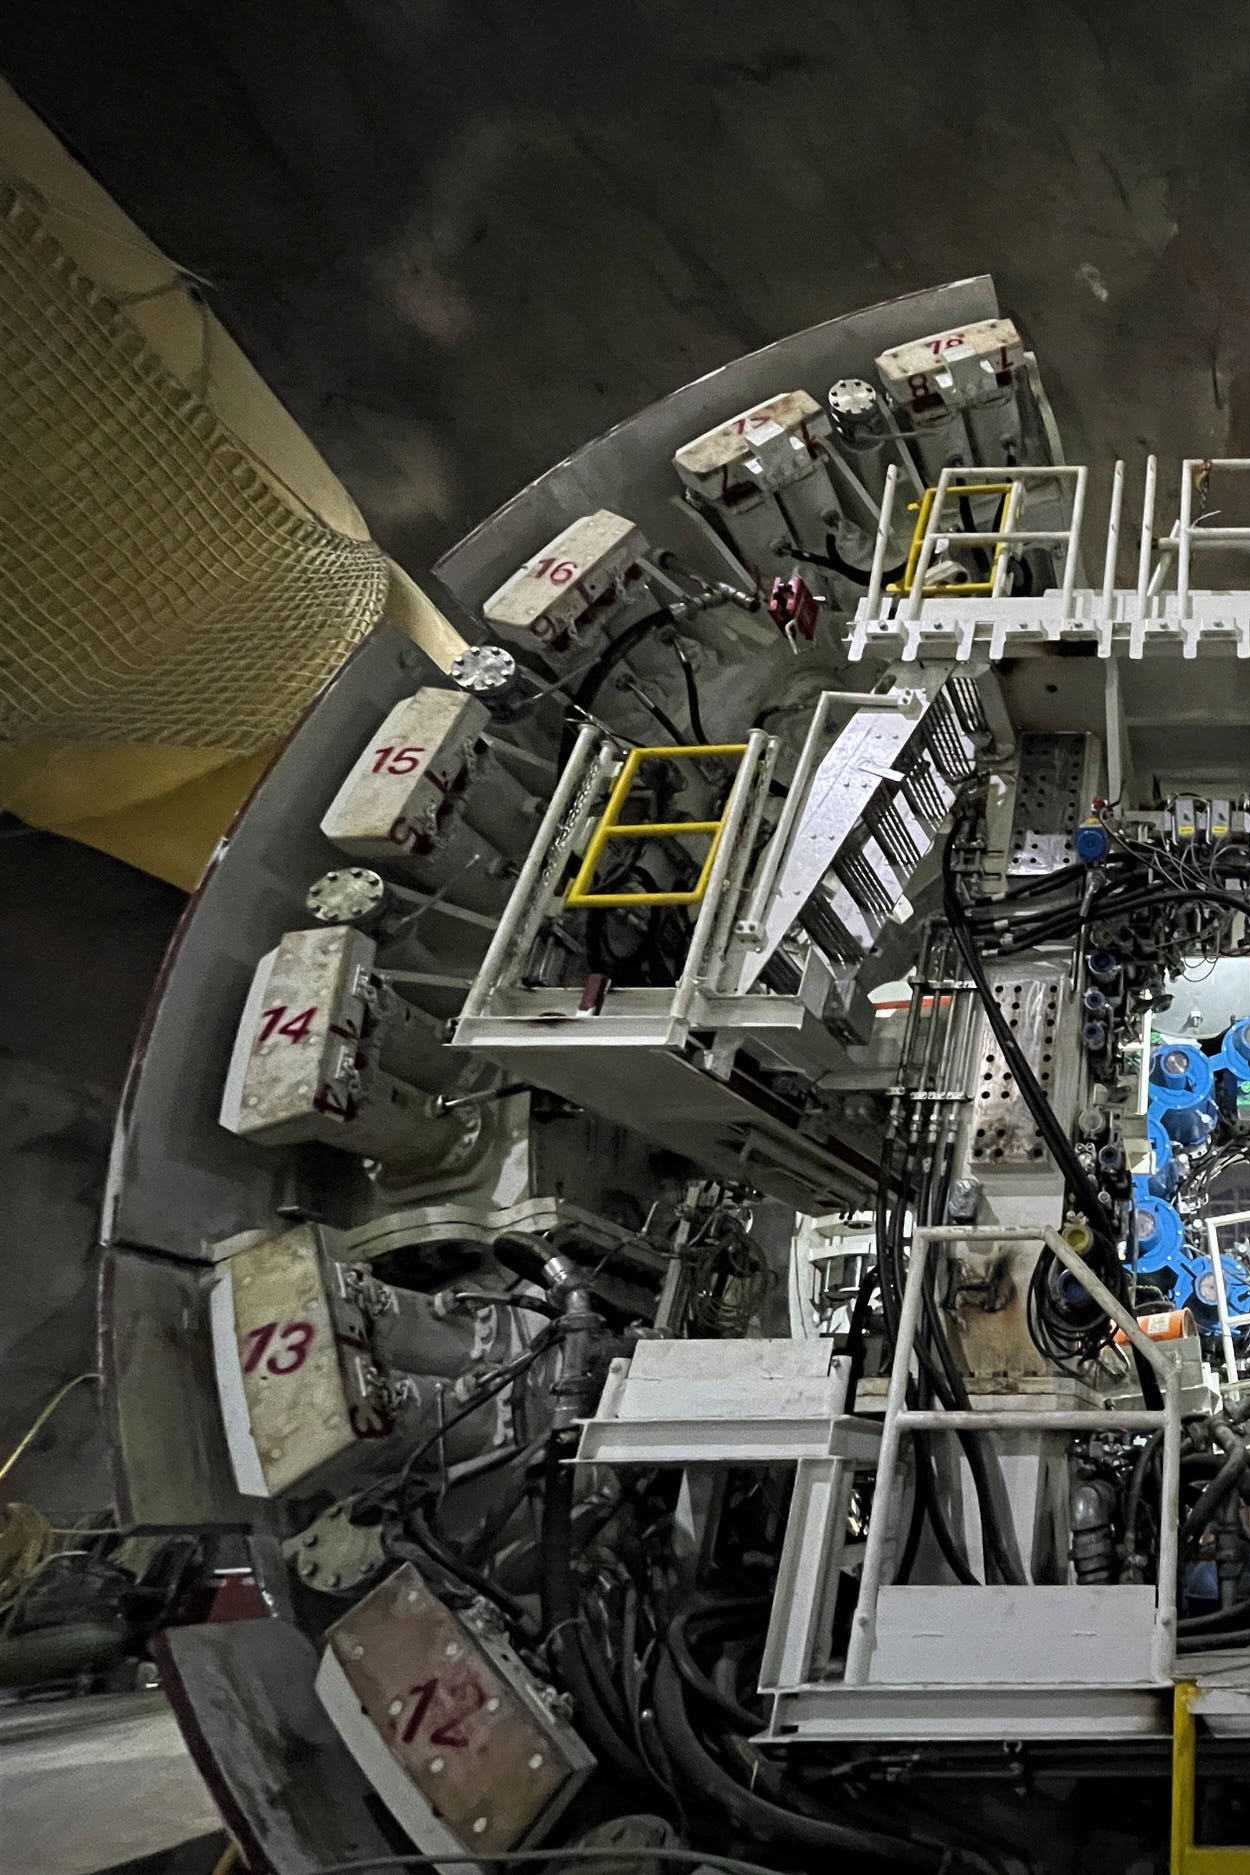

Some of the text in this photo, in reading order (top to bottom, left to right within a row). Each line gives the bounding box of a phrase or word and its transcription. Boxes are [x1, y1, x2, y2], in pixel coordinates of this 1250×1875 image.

[535, 557, 578, 586] 16
[371, 746, 426, 776] 15
[257, 1005, 318, 1046] 14
[242, 1321, 315, 1375] 13
[402, 1675, 488, 1748] 12
